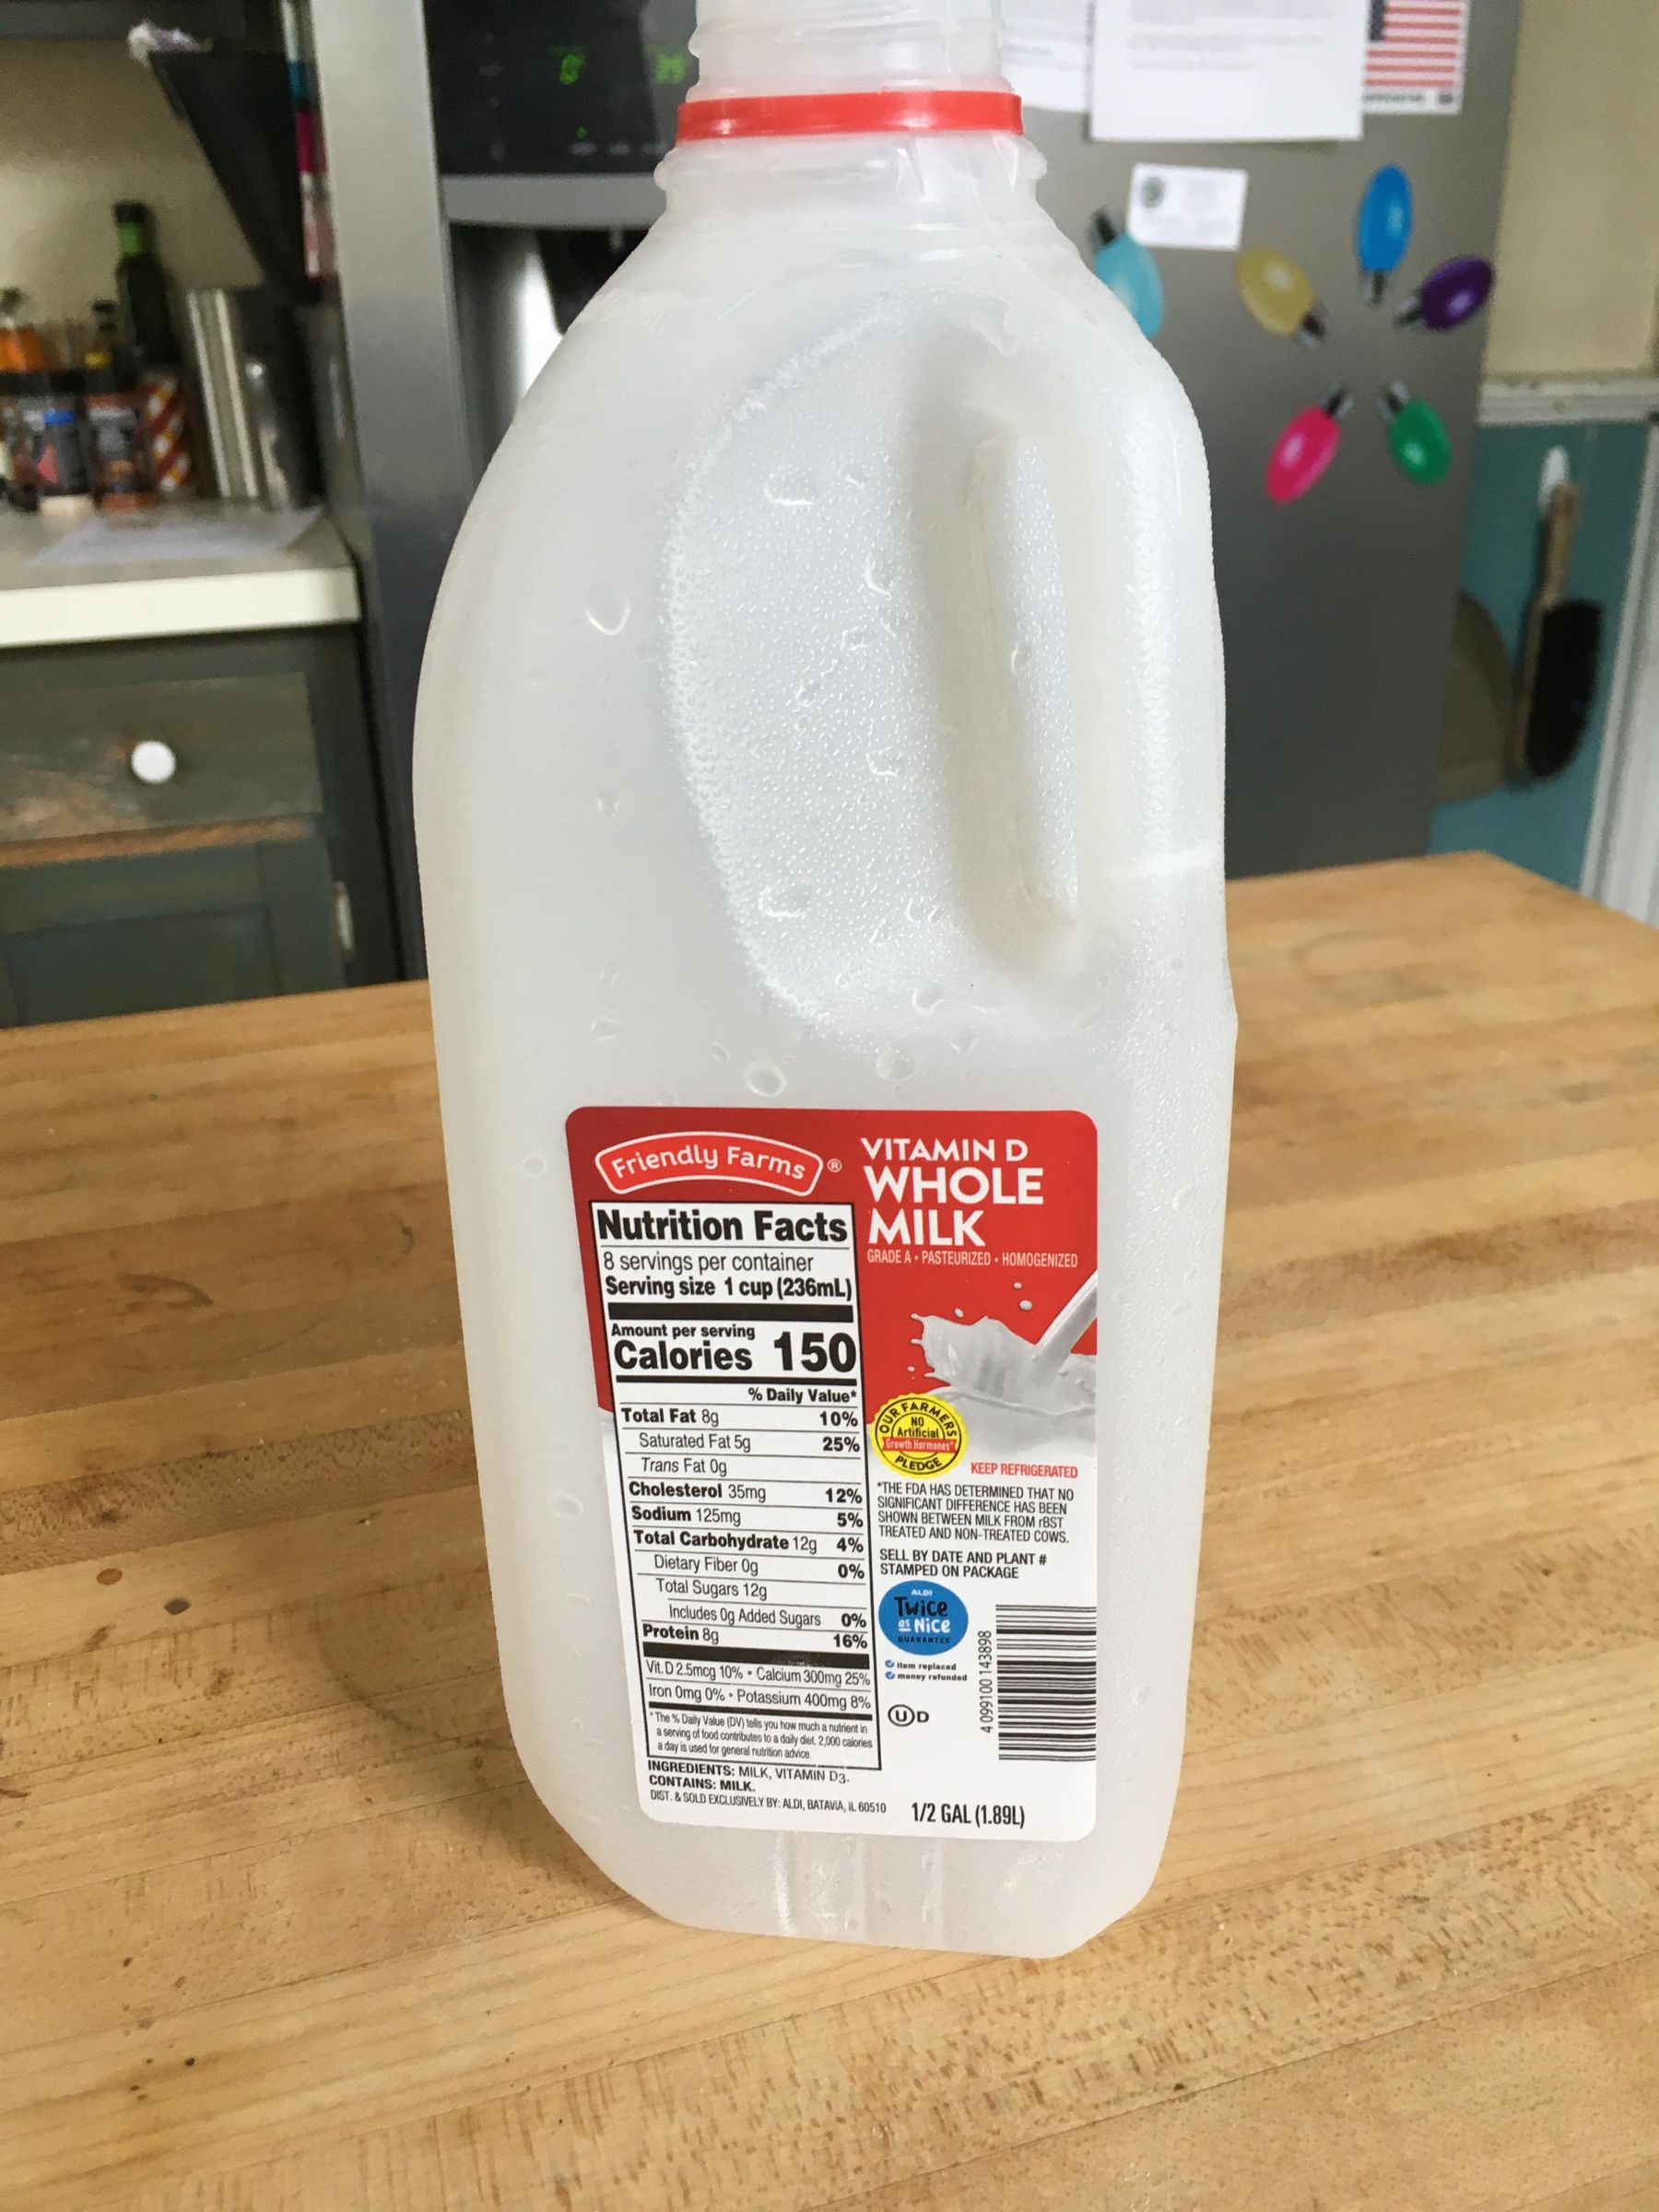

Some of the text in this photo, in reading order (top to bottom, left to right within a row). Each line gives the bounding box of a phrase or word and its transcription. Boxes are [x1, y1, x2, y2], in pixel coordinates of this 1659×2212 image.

[861, 1138, 1028, 1161] VITAMIN D
[611, 1145, 806, 1180] Friendly Farms
[864, 1165, 1044, 1205] WHOLE
[596, 1209, 847, 1241] Nutrition Facts
[868, 1207, 986, 1246] MILK
[604, 1252, 814, 1275] 8 servings per container
[867, 1249, 1077, 1267] GRADE A PASTEURIZED HOMOGENIZED
[606, 1276, 852, 1301] Serving size 1 cup (236mL)
[611, 1324, 755, 1339] Amount per serving
[614, 1331, 856, 1372] Calories 150
[767, 1388, 803, 1404] Daily
[621, 1408, 858, 1427] Total Fat 8g 10%
[879, 1402, 957, 1437] OUR FARMERS
[912, 1418, 924, 1426] NO
[639, 1432, 860, 1453] Saturated Fat 5g 25%
[898, 1427, 939, 1438] Artificial
[886, 1439, 912, 1449] Growth
[641, 1457, 726, 1477] Trans Fat 0g
[895, 1455, 942, 1470] PLEDGE
[971, 1463, 1078, 1478] KEEP REFRIGERATED
[629, 1481, 863, 1503] Cholesterol 35mg 12%
[906, 1483, 926, 1495] FDA
[930, 1484, 951, 1496] HAS
[955, 1485, 1023, 1499] DETERMINED
[1027, 1488, 1054, 1500] THAT
[1058, 1488, 1074, 1500] NO
[877, 1497, 1066, 1514] SIGNIFICANT DIFFERENCE HAS BEEN
[631, 1506, 864, 1527] Sodium 125mg 5%
[878, 1511, 1063, 1528] SHOWN BETWEEN MILK FROM rBST
[634, 1529, 864, 1554] Total Carbohydrate 12g 4%
[879, 1525, 1069, 1543] TREATED AND NON-TREATED COWS.
[654, 1554, 865, 1579] Dietary Fiber 0g 0%
[880, 1548, 1035, 1564] SELL BY DATE AND PLANT
[880, 1562, 1018, 1578] STAMPED ON PACKAGE
[656, 1578, 767, 1601] Total Sugars 12g
[669, 1604, 866, 1630] Includes 0g Added Sugars 0%
[643, 1623, 867, 1650] Protein 8g 16%
[898, 1636, 950, 1644] GUARANTEE
[677, 1662, 716, 1681] 2.5mcg
[720, 1664, 743, 1679] 10%
[756, 1667, 801, 1683] Calcium
[804, 1670, 841, 1688] 300mg
[844, 1671, 870, 1687] 25%
[898, 1673, 968, 1681] money refunded
[918, 1663, 957, 1671] replaced
[649, 1684, 871, 1711] Iron 0mg 0% Potassium 400mg 8%
[655, 1712, 858, 1733] The Daily Value much nutrient
[664, 1726, 872, 1748] serving food contributes daily 2,000 calories
[688, 1743, 782, 1758] used general nutrition
[648, 1759, 735, 1776] INGREDIENTS:
[738, 1765, 771, 1780] MILK,
[775, 1768, 826, 1781] VITAMIN
[650, 1775, 756, 1792] CONTAINS: MILK.
[683, 1793, 886, 1813] SOLD EXCLUSIVELY ALDI, BATAVIA, 60510
[912, 1801, 1025, 1828] 1/2 GAL (1.89L)
